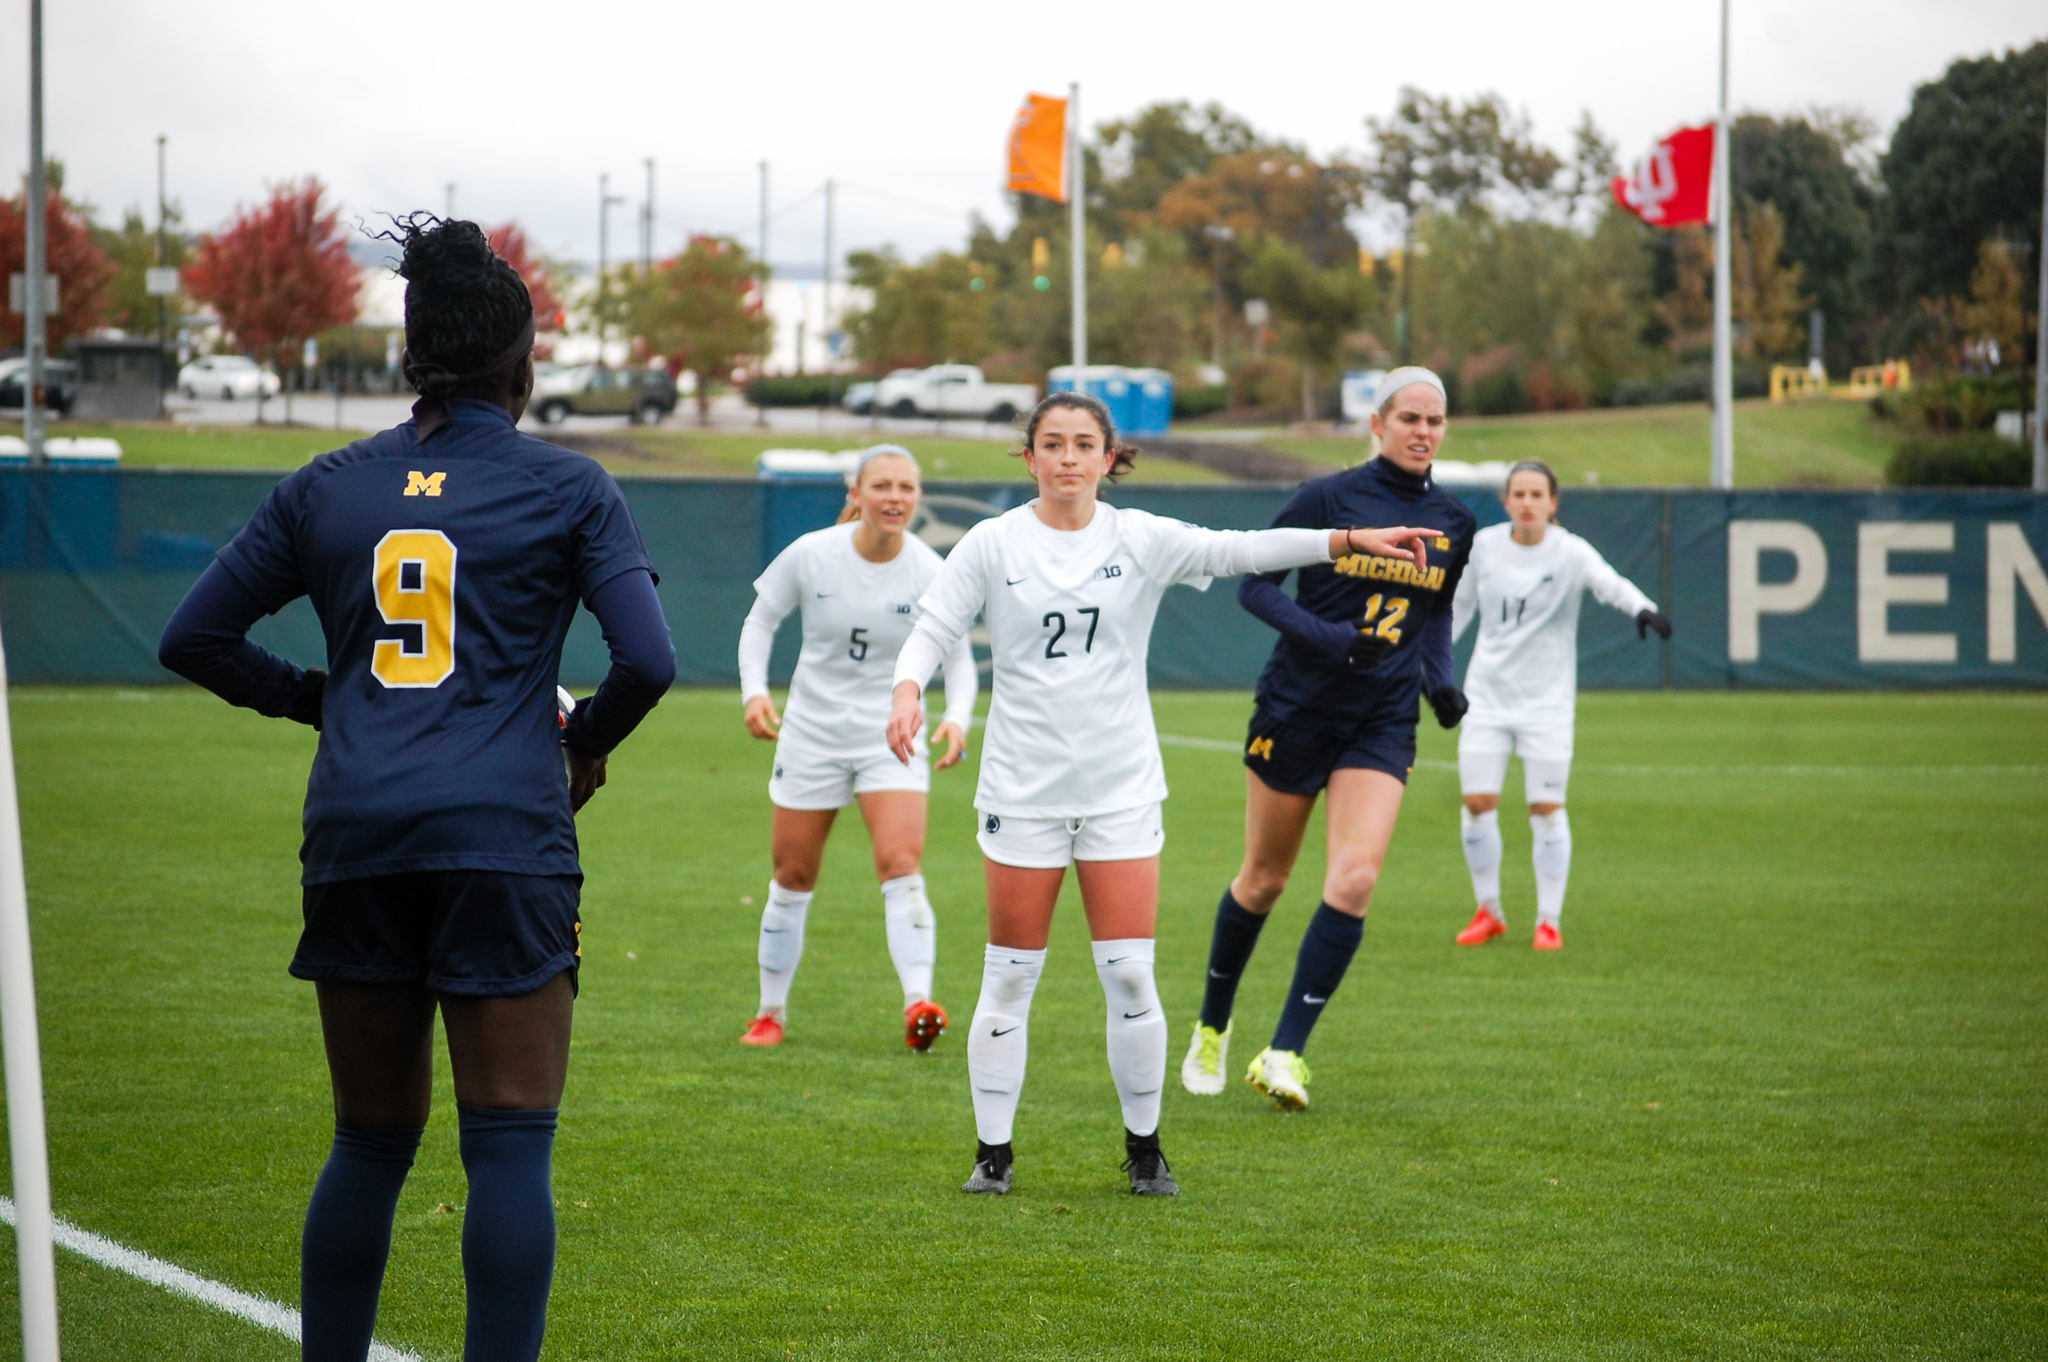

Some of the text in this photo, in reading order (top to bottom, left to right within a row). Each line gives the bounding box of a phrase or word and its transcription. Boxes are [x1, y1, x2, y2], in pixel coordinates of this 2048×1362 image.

[403, 471, 446, 496] M
[371, 530, 457, 688] 9
[1502, 597, 1527, 626] 17
[1728, 519, 2048, 663] PEN
[848, 626, 868, 662] 5
[1042, 606, 1100, 659] 27
[1361, 593, 1409, 644] 12
